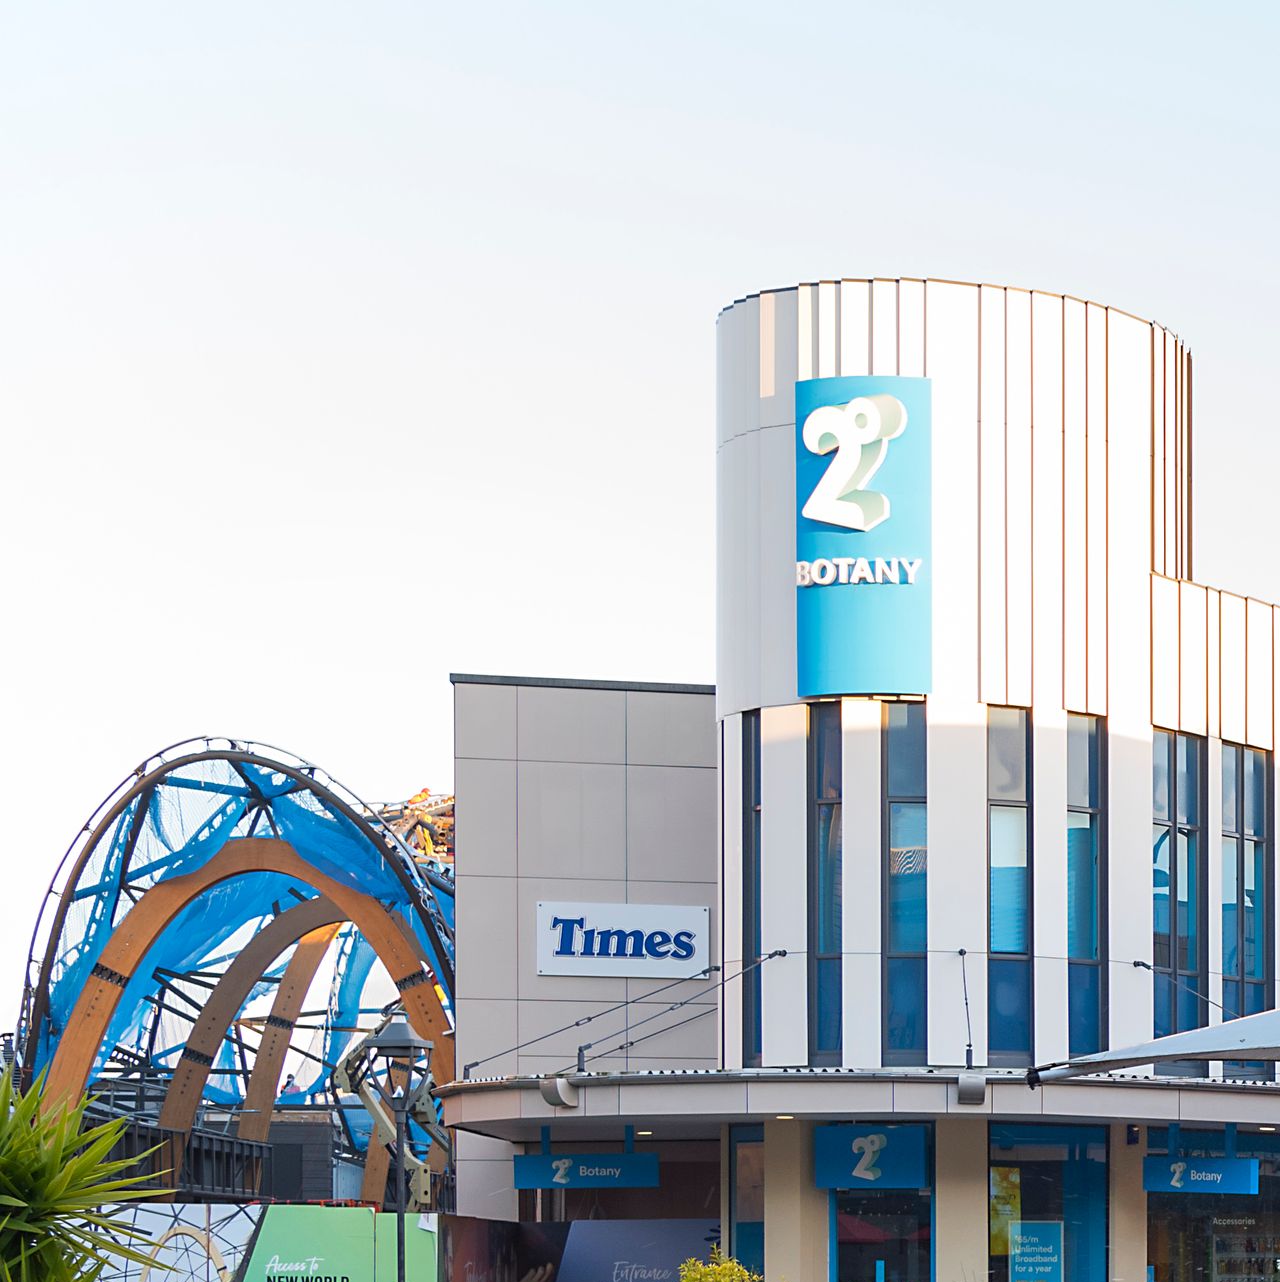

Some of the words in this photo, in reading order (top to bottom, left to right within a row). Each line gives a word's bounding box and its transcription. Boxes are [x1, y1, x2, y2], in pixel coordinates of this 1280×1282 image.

[796, 557, 923, 587] BOTANY
[550, 916, 696, 959] Times
[579, 1166, 621, 1178] Botany
[1190, 1170, 1222, 1183] Botany
[1213, 1217, 1256, 1225] Accessories
[1015, 1245, 1053, 1253] Unlimited
[265, 1255, 306, 1275] Access
[1015, 1255, 1058, 1263] Broadband
[611, 1261, 672, 1282] Entrance
[1035, 1266, 1052, 1274] year
